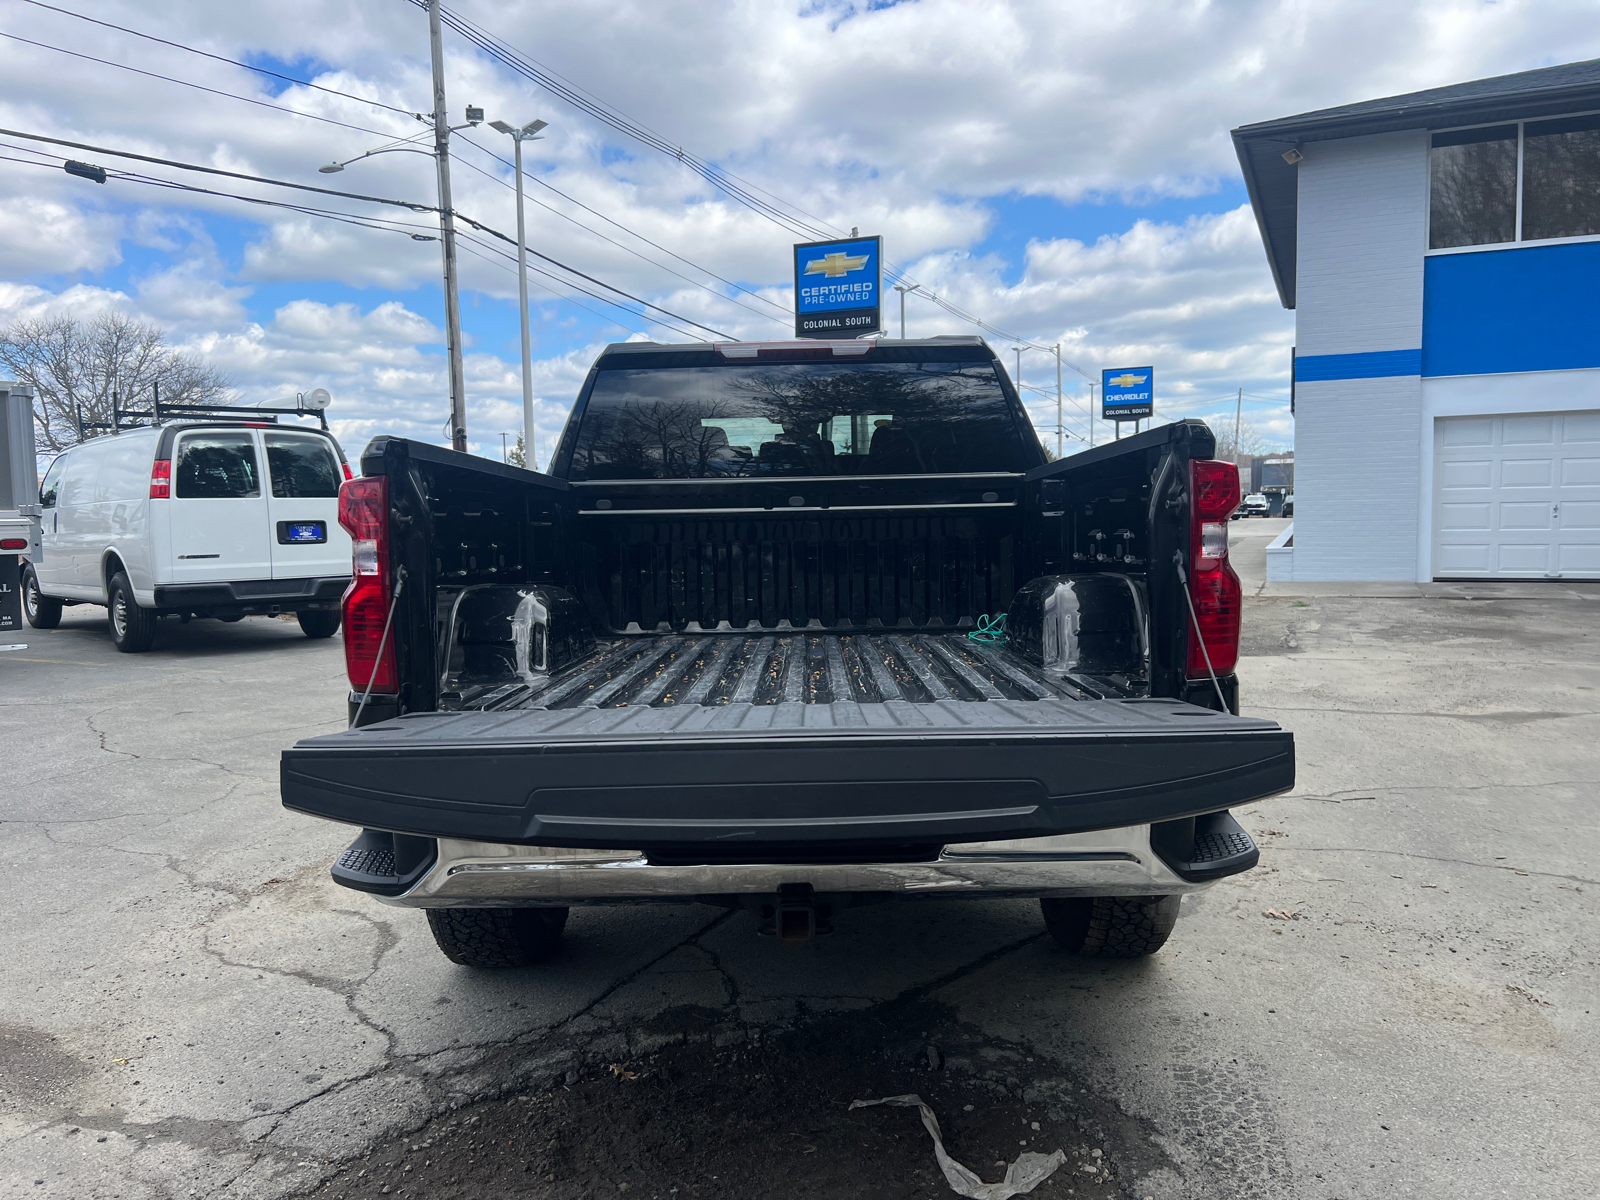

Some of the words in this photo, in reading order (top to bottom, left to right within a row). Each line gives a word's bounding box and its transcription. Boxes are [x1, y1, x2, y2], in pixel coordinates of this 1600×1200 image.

[801, 282, 873, 296] CERTIFIED
[805, 292, 869, 305] PRE-OWNED
[803, 319, 841, 329] COLONIAL
[845, 316, 871, 325] SOUTH
[1106, 392, 1149, 402] CHEVROLET
